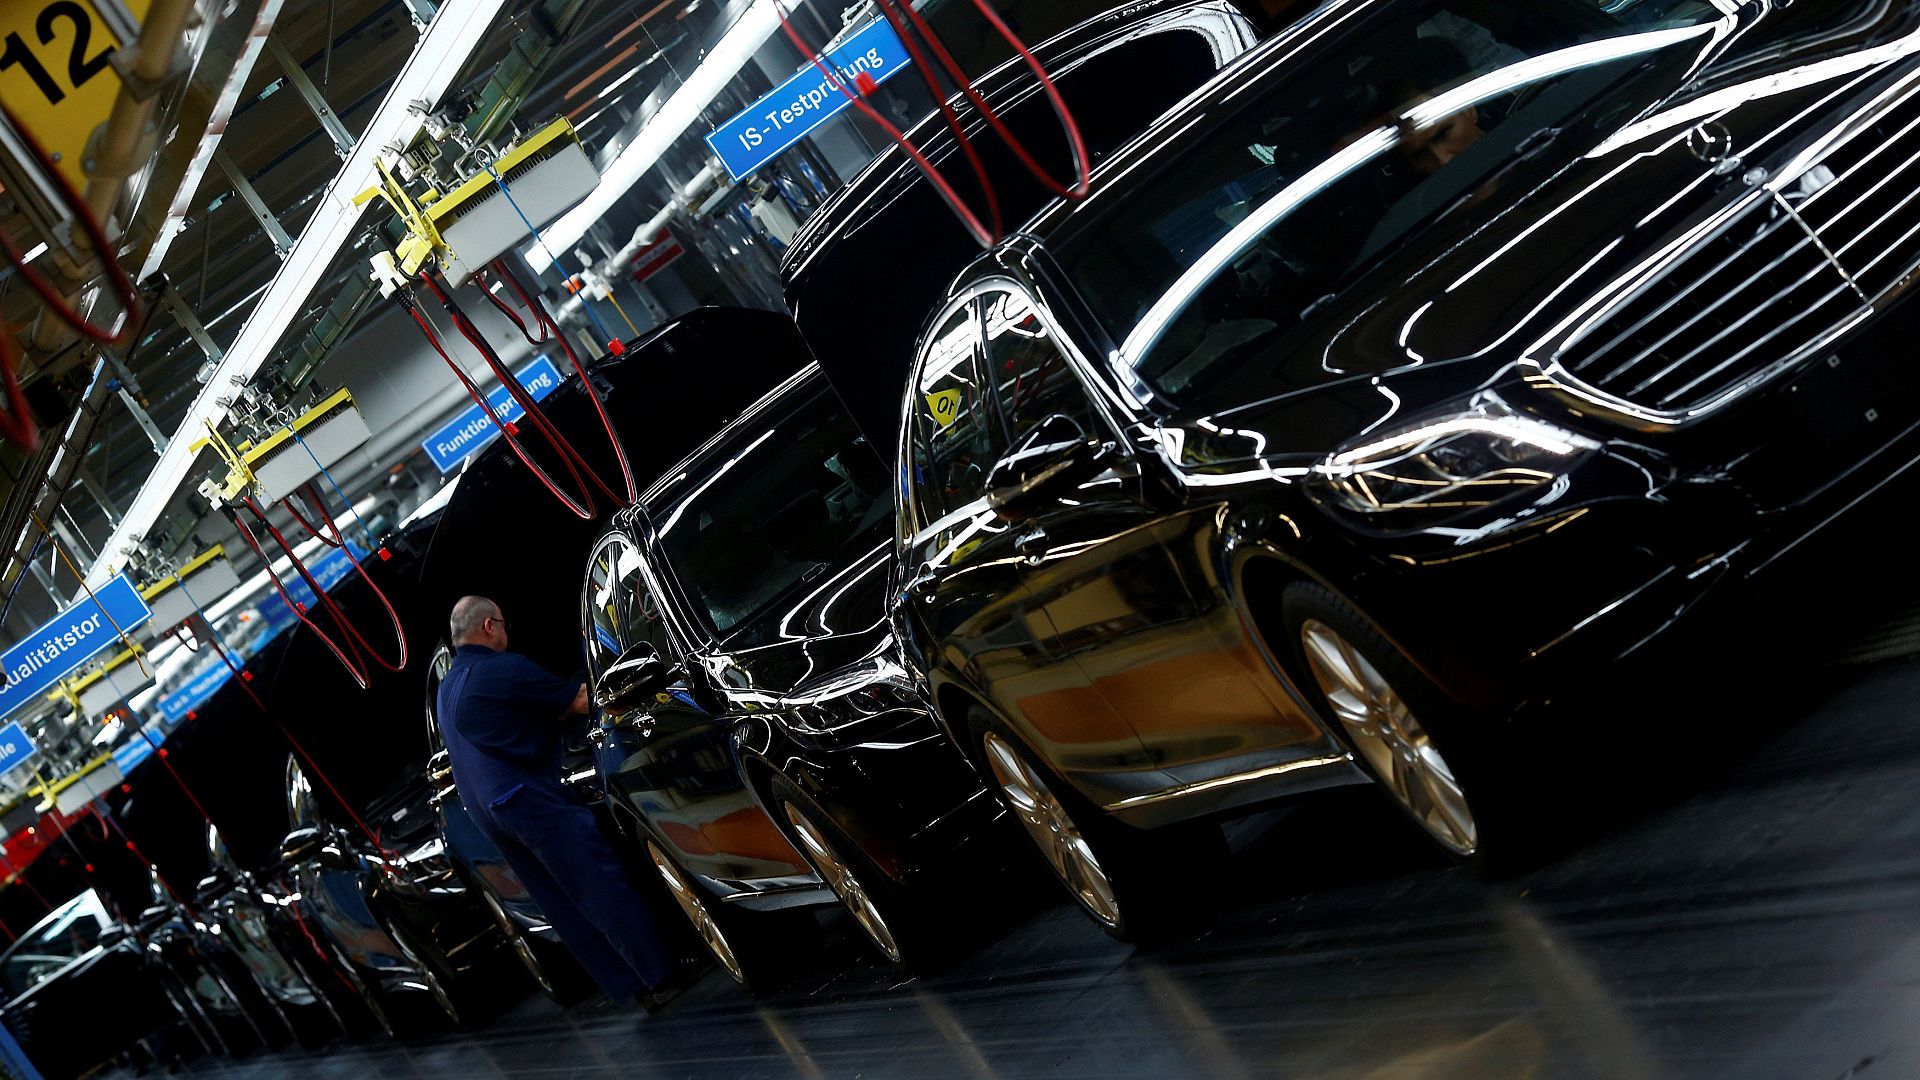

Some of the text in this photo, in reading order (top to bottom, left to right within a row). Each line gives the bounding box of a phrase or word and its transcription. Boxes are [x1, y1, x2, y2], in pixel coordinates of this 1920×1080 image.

[0, 1, 116, 106] 12
[738, 47, 884, 151] IS-Testprüfung
[436, 371, 553, 458] Funktionprung
